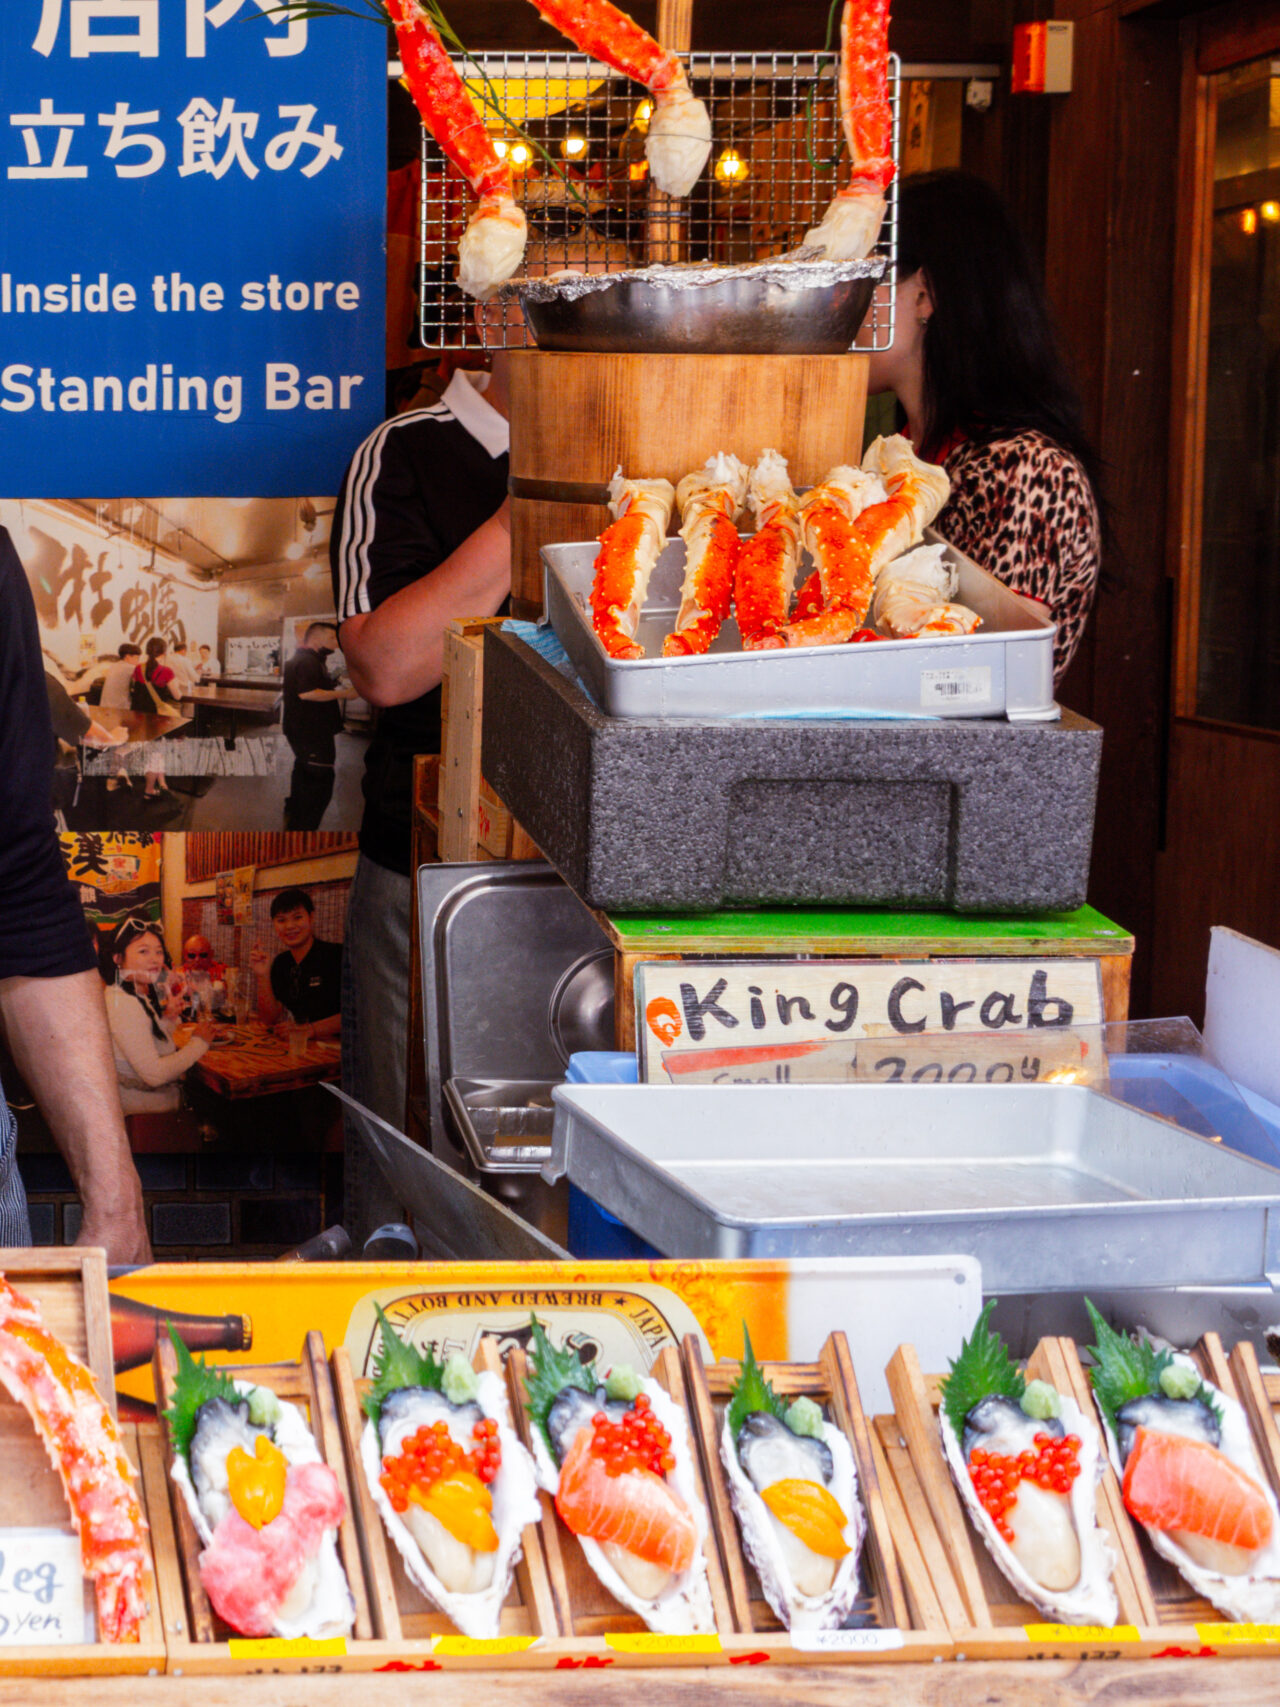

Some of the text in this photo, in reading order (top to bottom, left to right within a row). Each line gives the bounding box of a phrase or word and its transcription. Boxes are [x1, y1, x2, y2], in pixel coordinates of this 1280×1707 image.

[7, 97, 344, 180] 立ち飲み
[1, 273, 360, 313] Inside the store
[0, 363, 364, 423] Standing Bar
[679, 970, 1074, 1042] King Crab
[458, 1293, 500, 1307] AND
[513, 1292, 603, 1307] BREWED
[629, 1308, 668, 1349] JAPA
